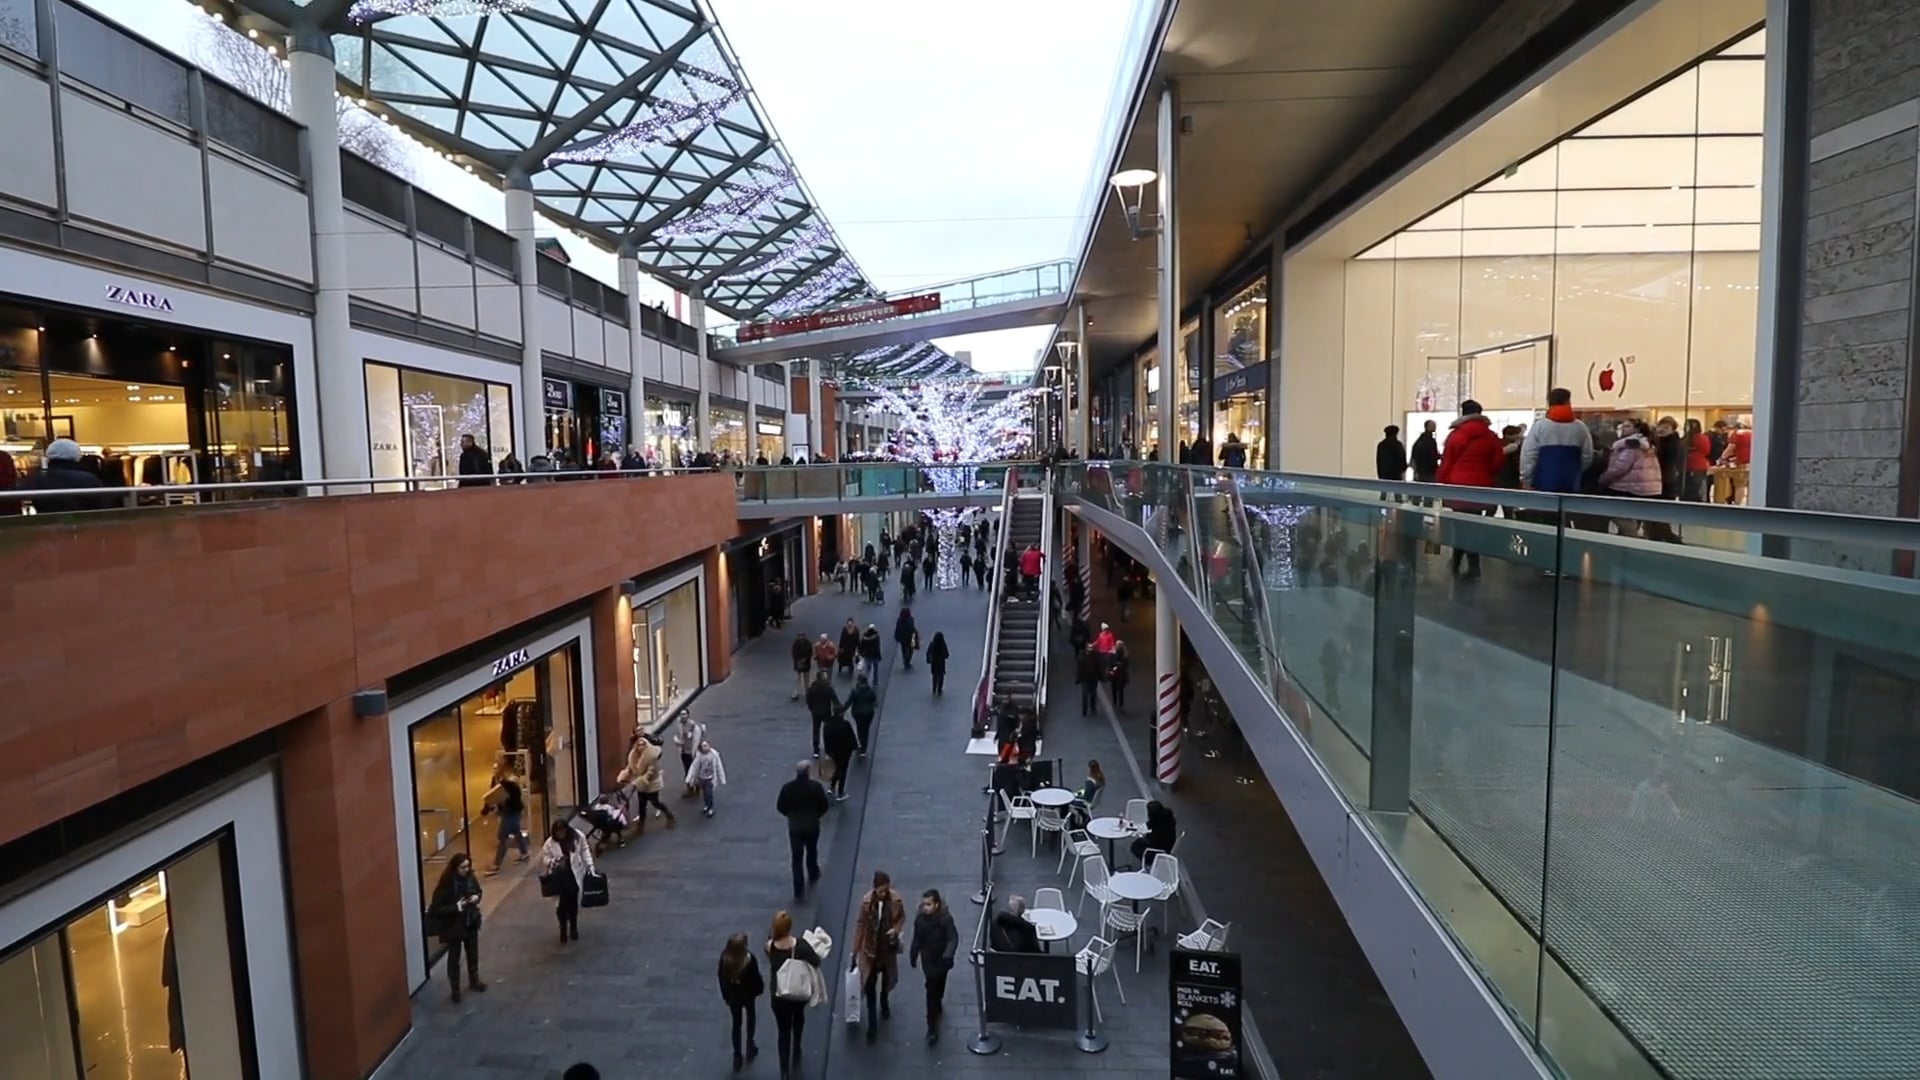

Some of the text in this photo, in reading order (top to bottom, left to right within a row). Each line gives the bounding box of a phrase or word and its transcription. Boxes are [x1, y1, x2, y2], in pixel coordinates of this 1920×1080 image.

[105, 284, 174, 313] ZARA
[373, 442, 398, 451] ZARA
[492, 647, 530, 677] ZARA
[1189, 959, 1221, 974] EAT.
[995, 975, 1066, 1004] EAT.
[1176, 992, 1219, 1005] BLANKETS
